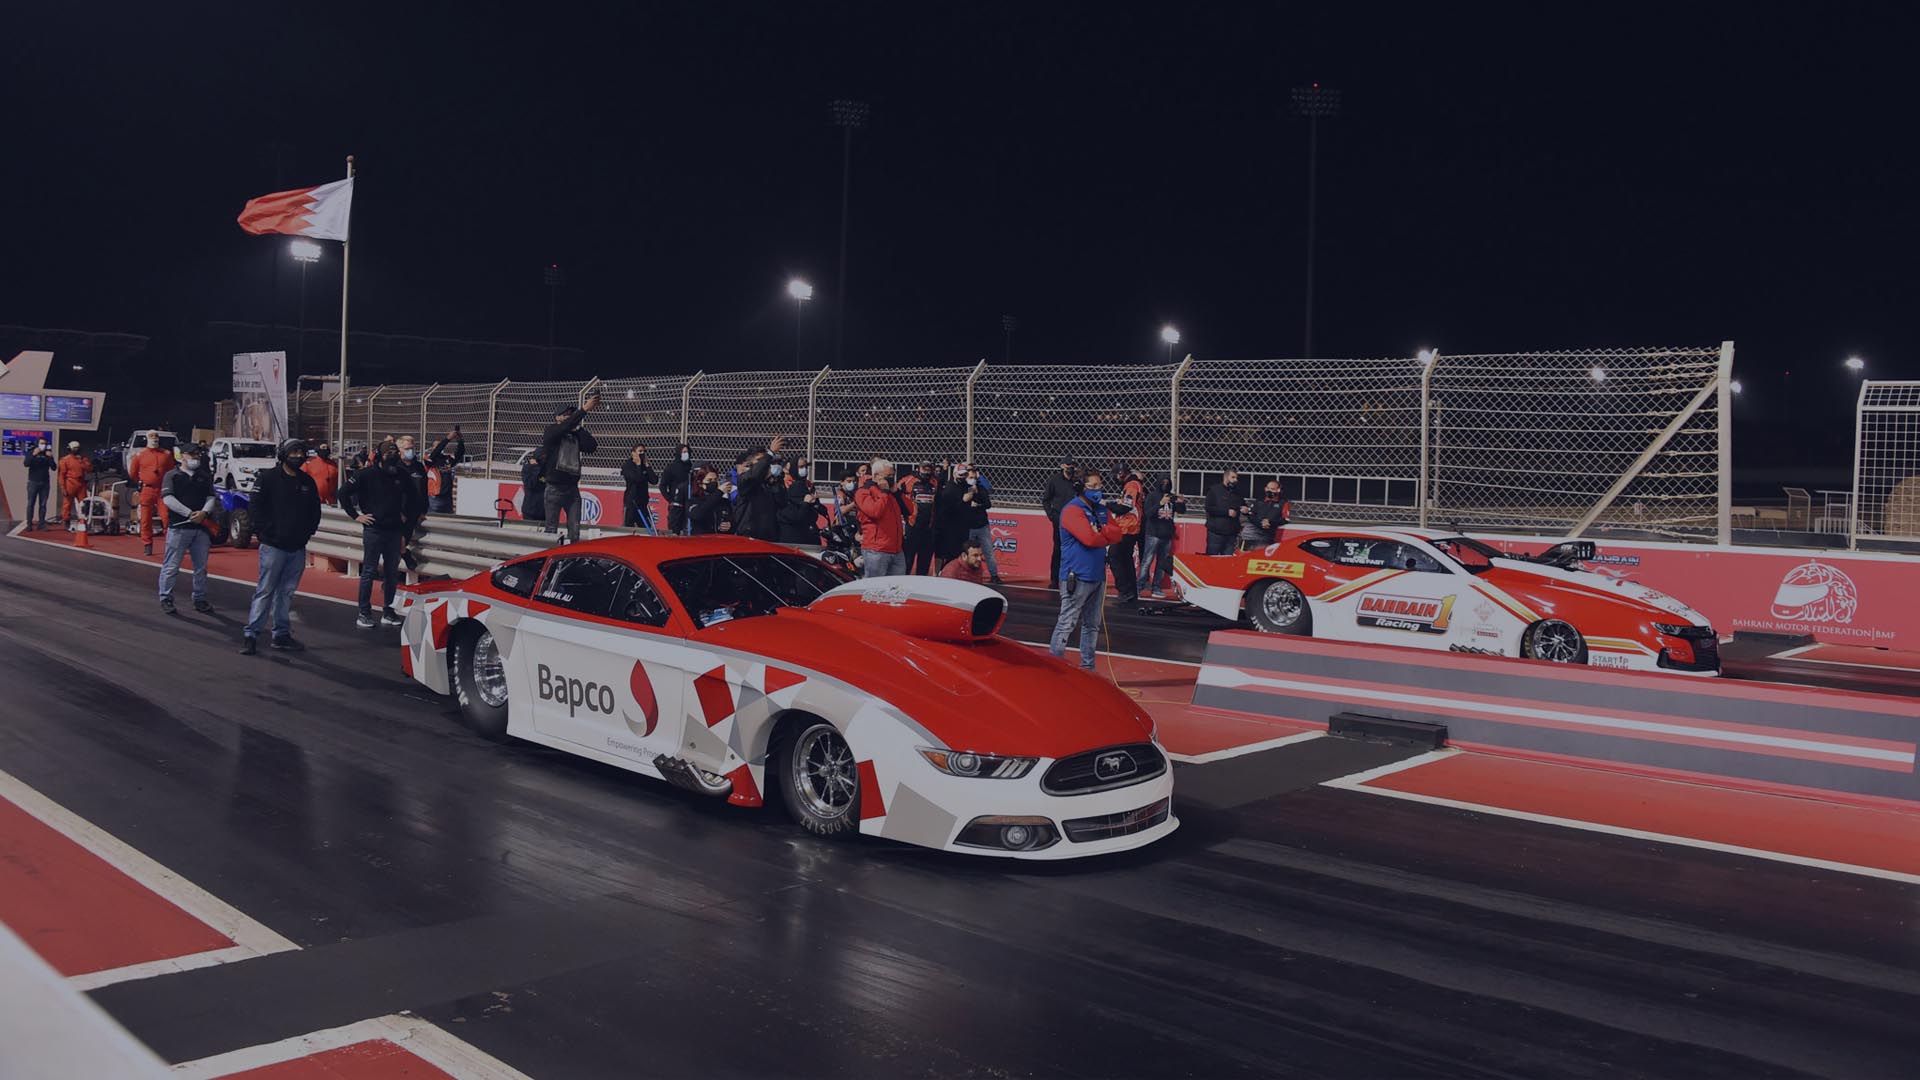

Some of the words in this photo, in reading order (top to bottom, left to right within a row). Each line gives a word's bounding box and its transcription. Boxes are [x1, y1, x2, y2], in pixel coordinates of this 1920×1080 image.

[1255, 562, 1295, 574] DHL
[1360, 597, 1438, 618] BAHRAIN
[1375, 618, 1421, 631] Racing
[1732, 618, 1774, 630] BAHRAIN
[1775, 622, 1810, 632] MOTOR
[537, 663, 615, 718] Bapco
